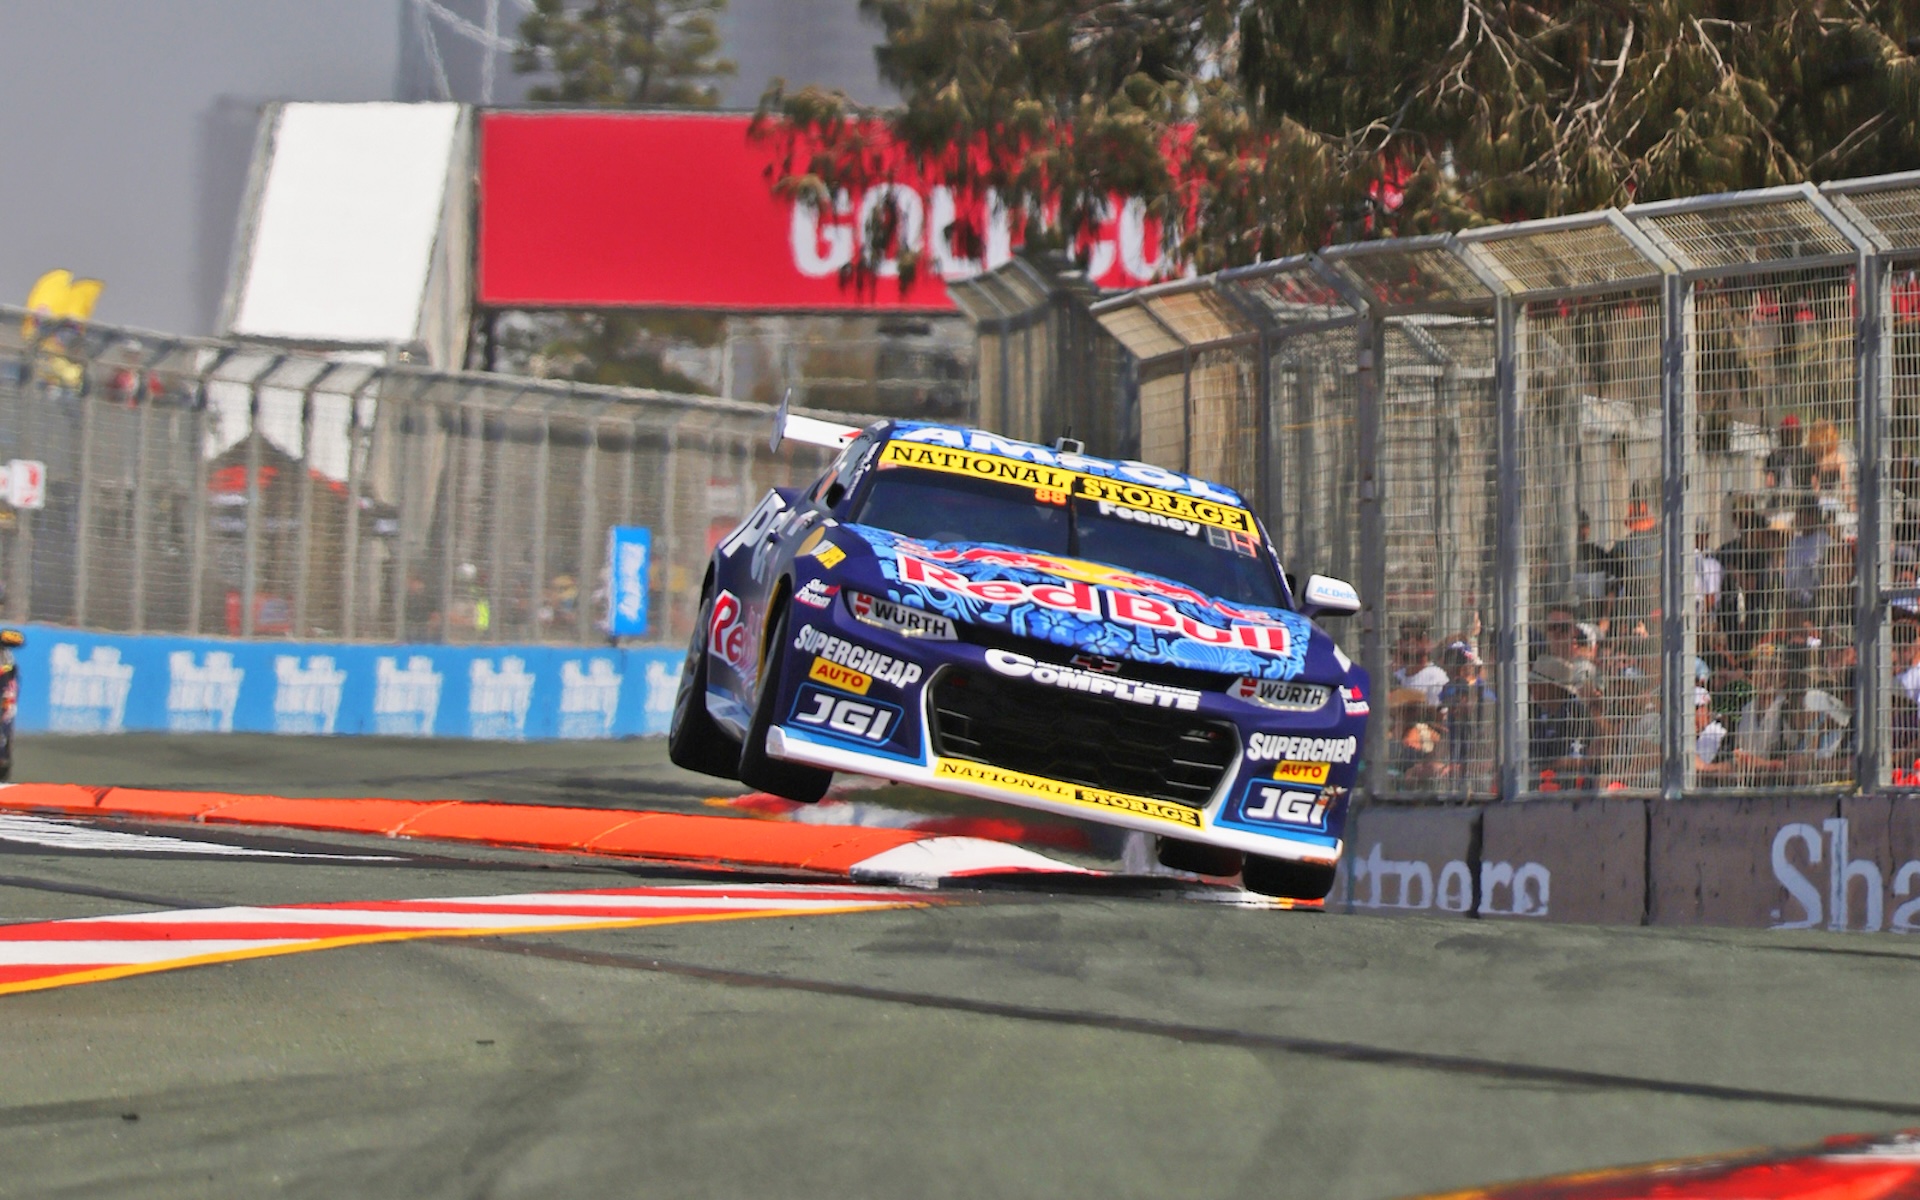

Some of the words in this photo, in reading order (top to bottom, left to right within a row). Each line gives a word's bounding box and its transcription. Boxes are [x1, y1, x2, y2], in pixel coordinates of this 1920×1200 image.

[891, 445, 1066, 490] NATIONAL
[1082, 477, 1244, 530] STORAGE
[902, 425, 1241, 507] AMPOL
[1034, 487, 1067, 506] 88
[1098, 501, 1201, 537] Feeney
[875, 601, 947, 637] WÜRTH
[898, 554, 1102, 615] Red
[1107, 588, 1291, 656] Bull
[794, 624, 923, 689] SUPERCHEAP
[816, 664, 864, 688] AUTO
[984, 648, 1201, 712] COMPLETE
[1259, 682, 1324, 705] WÜRTH
[796, 693, 893, 740] JGI
[1280, 763, 1322, 778] AUTO
[941, 762, 1069, 796] NATIONAL
[1081, 789, 1198, 827] STORAGE
[1246, 786, 1327, 825] JGI
